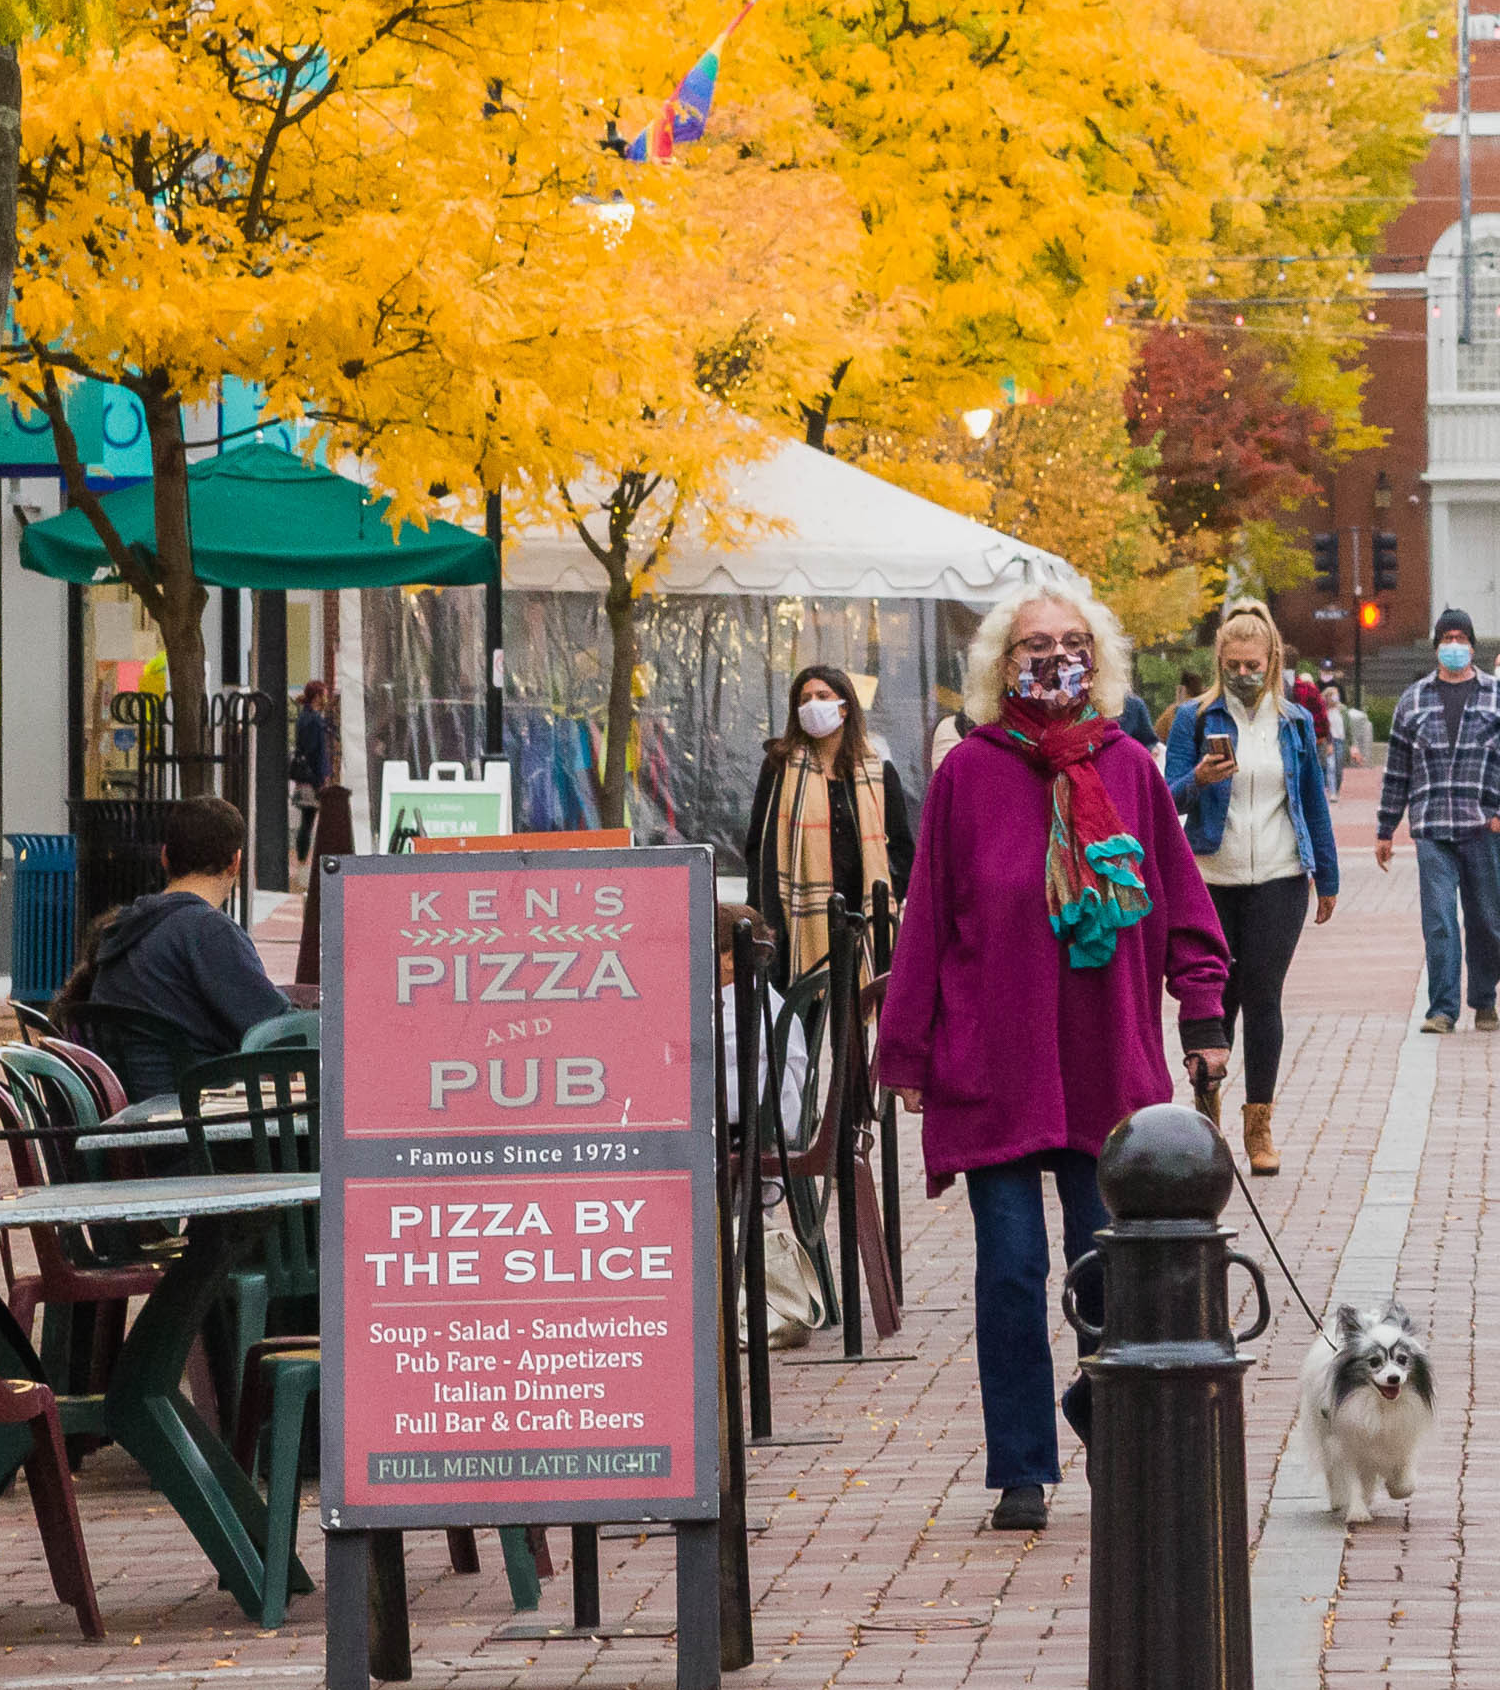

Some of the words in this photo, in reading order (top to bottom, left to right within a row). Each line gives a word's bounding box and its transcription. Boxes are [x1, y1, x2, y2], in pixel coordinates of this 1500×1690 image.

[409, 880, 626, 922] KEN'S
[395, 949, 641, 1005] PIZZA
[484, 1017, 552, 1048] AND
[427, 1057, 607, 1111] PUB
[409, 1148, 495, 1167] Famous
[503, 1145, 563, 1165] Since
[572, 1143, 627, 1162] 1973
[390, 1202, 554, 1240] PIZZA
[575, 1199, 647, 1235] BY
[364, 1250, 481, 1287] THE
[503, 1245, 674, 1284] SLICE
[370, 1322, 428, 1348] Soup
[448, 1319, 511, 1343] Salad
[531, 1315, 669, 1341] Sandwiches
[395, 1352, 440, 1374] Pub
[446, 1351, 498, 1373] Fare
[516, 1348, 643, 1375] Appetizers
[433, 1381, 507, 1403] Italian
[514, 1379, 606, 1402] Dinners
[395, 1412, 438, 1434] Full
[444, 1411, 487, 1433] Bar
[490, 1411, 511, 1432] &
[516, 1408, 574, 1432] Craft
[579, 1408, 645, 1431] Beers
[377, 1458, 438, 1480] FULL
[443, 1456, 515, 1478] MENU
[520, 1454, 580, 1476] LATE
[586, 1452, 662, 1474] NIGHT
